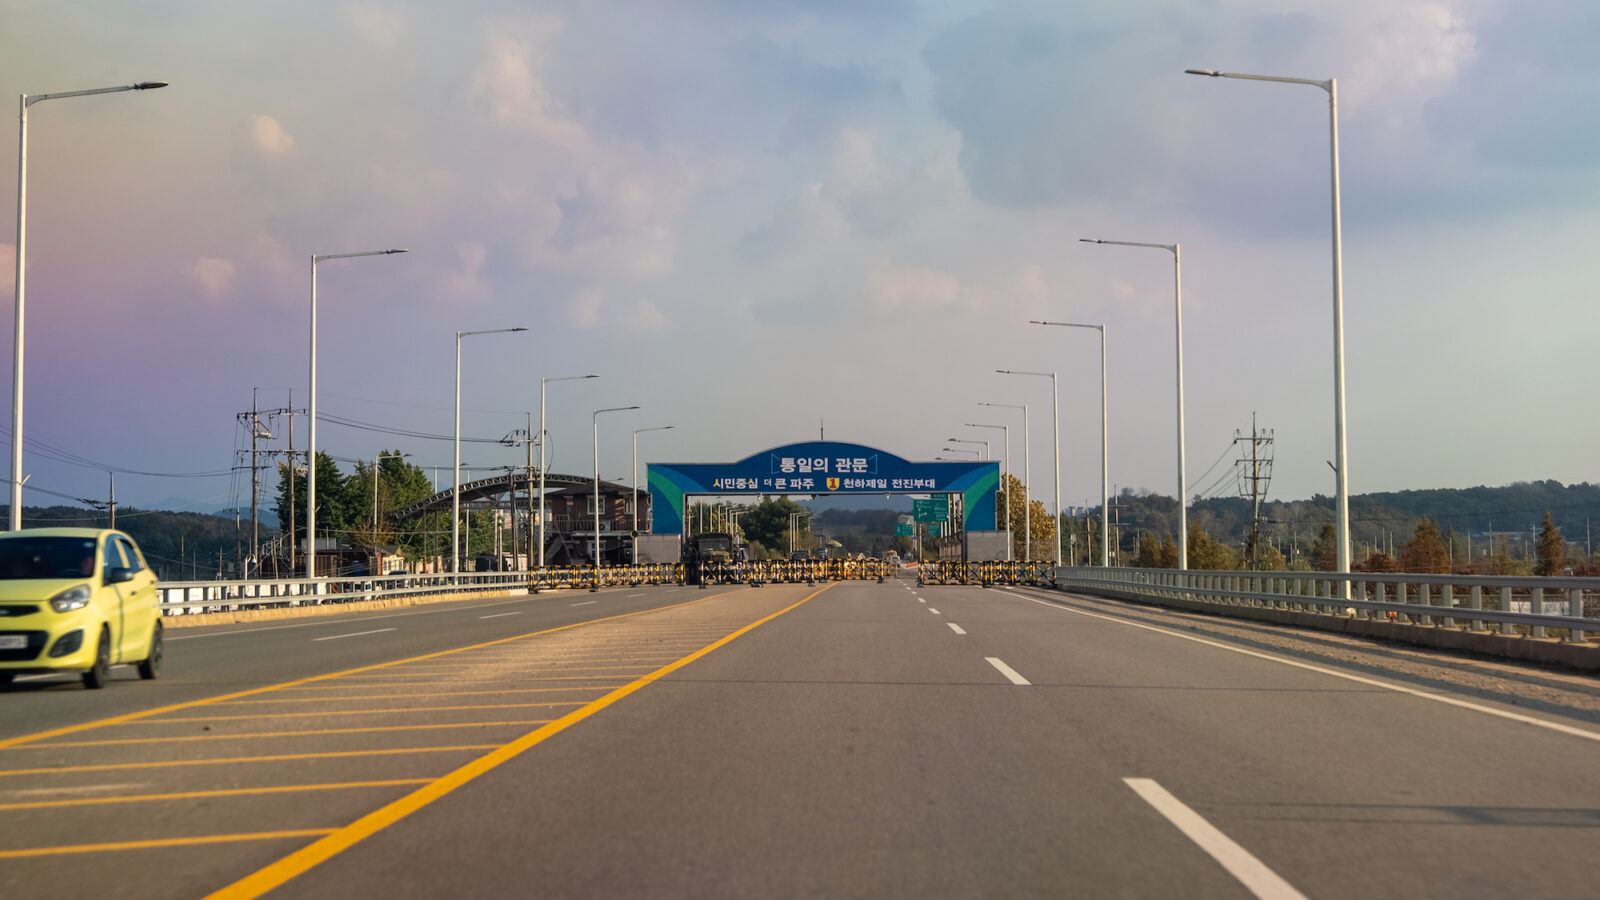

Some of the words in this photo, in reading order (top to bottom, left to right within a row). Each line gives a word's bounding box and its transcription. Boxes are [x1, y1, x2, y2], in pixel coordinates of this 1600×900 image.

[780, 457, 829, 473] 통일의
[835, 457, 868, 473] 관문
[713, 478, 758, 489] 시민중심
[764, 479, 772, 487] 더
[775, 478, 786, 489] 큰
[790, 478, 814, 490] 파주
[829, 478, 836, 489] 1
[843, 478, 887, 489] 천하제일
[891, 478, 936, 489] 전진부대
